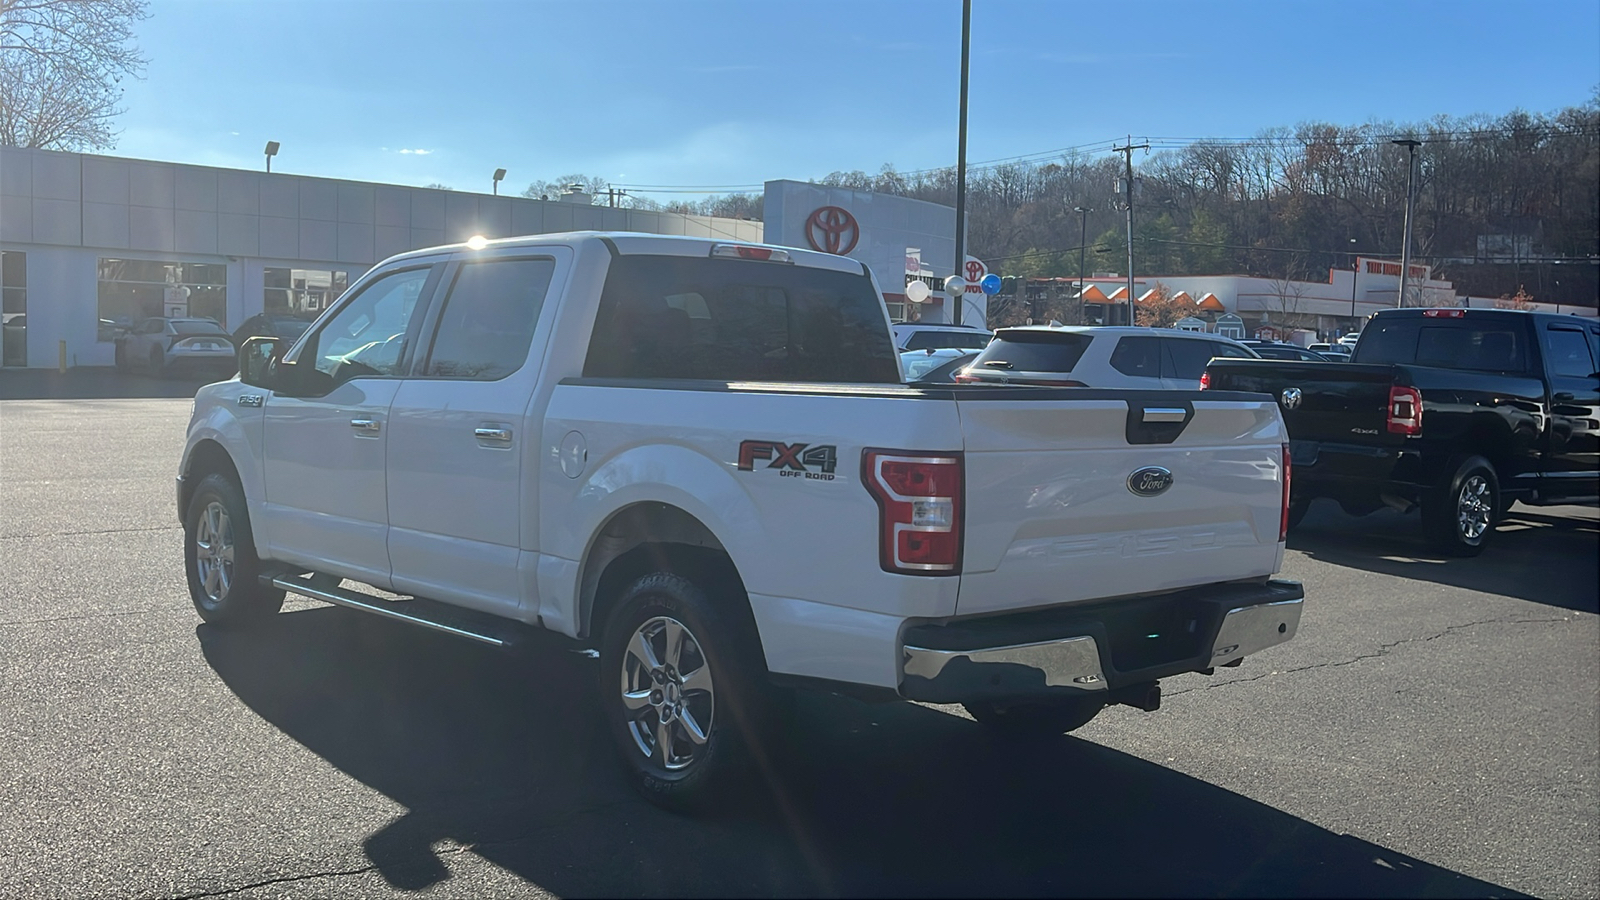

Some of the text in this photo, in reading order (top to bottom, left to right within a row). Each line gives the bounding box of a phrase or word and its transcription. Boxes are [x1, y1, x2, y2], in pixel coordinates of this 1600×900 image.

[738, 439, 837, 474] FX4
[779, 470, 835, 481] OFF ROAD
[1140, 472, 1165, 490] Ford
